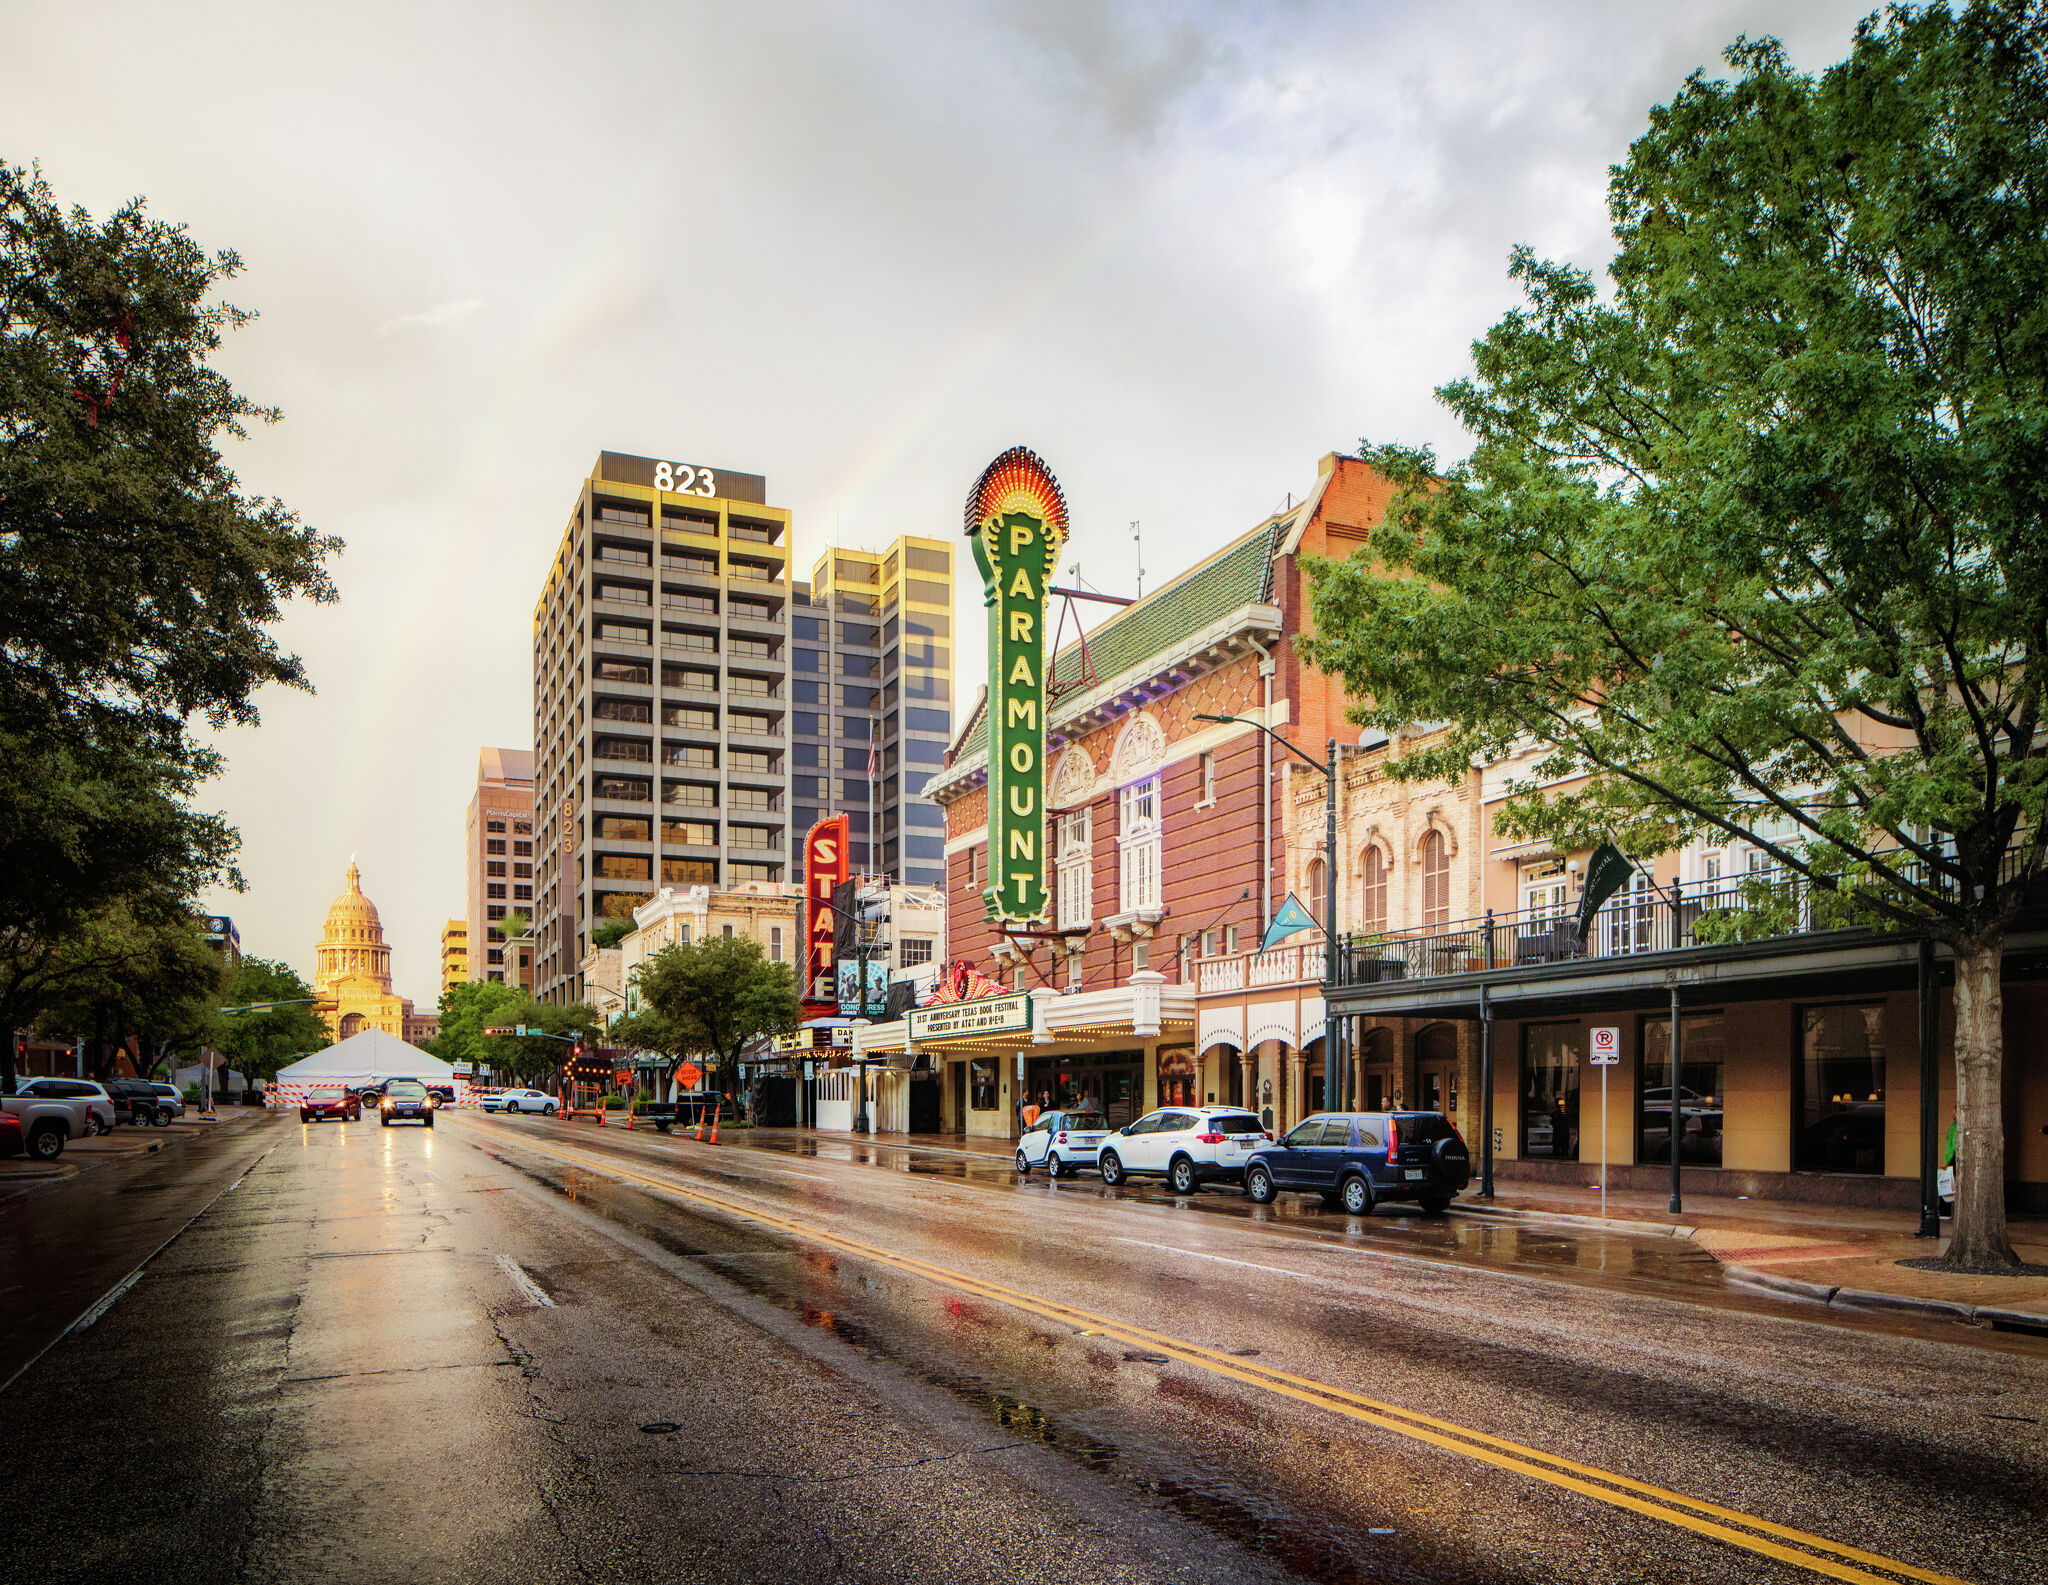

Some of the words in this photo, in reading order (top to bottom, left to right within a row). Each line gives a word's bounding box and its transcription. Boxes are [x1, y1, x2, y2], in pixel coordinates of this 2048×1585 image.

[654, 461, 716, 498] 823
[1008, 525, 1035, 904] PARAMOUNT
[563, 802, 573, 853] 823
[813, 838, 837, 1002] STATE
[917, 1014, 928, 1023] 21ST
[930, 1009, 960, 1022] ANNIVERSARY
[962, 1006, 977, 1017] TEXAS
[979, 1005, 992, 1015] BOOK
[994, 1001, 1019, 1013] FESTIVAL
[927, 1022, 951, 1032] PRESENTED
[953, 1021, 959, 1029] BY
[961, 1018, 975, 1028] AT&T
[976, 1017, 987, 1026] AND
